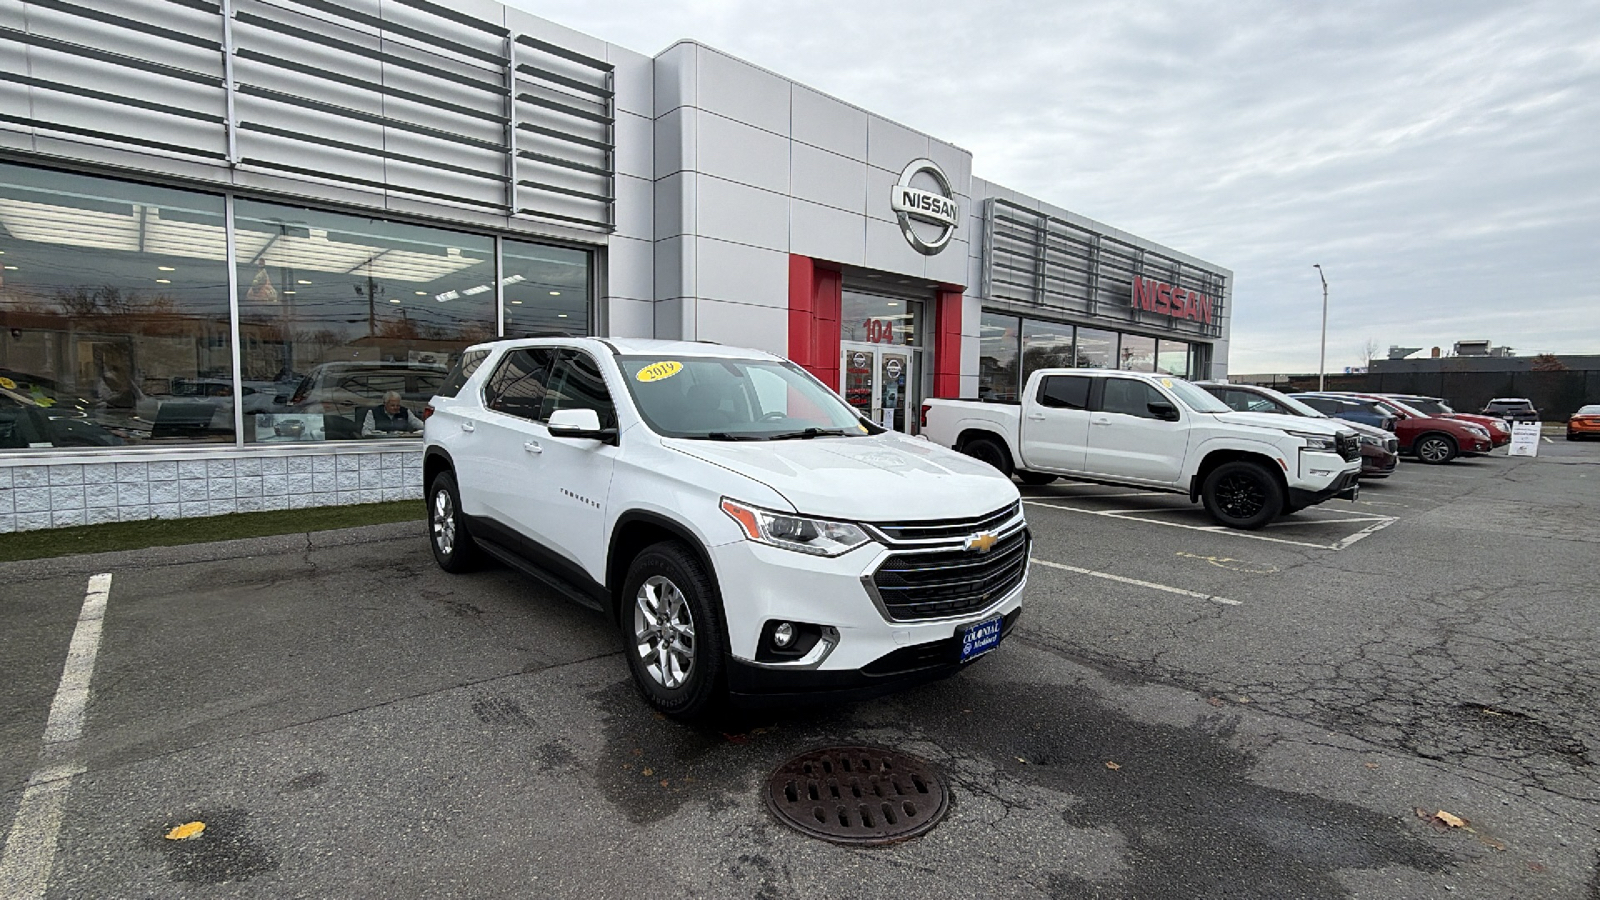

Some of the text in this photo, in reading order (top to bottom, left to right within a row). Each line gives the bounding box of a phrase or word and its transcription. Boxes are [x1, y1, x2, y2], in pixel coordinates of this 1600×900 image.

[903, 191, 957, 221] NISSAN
[1131, 275, 1212, 325] NISSAN
[863, 318, 894, 344] 104
[646, 363, 674, 379] 2019
[963, 622, 1000, 644] COLONIAL
